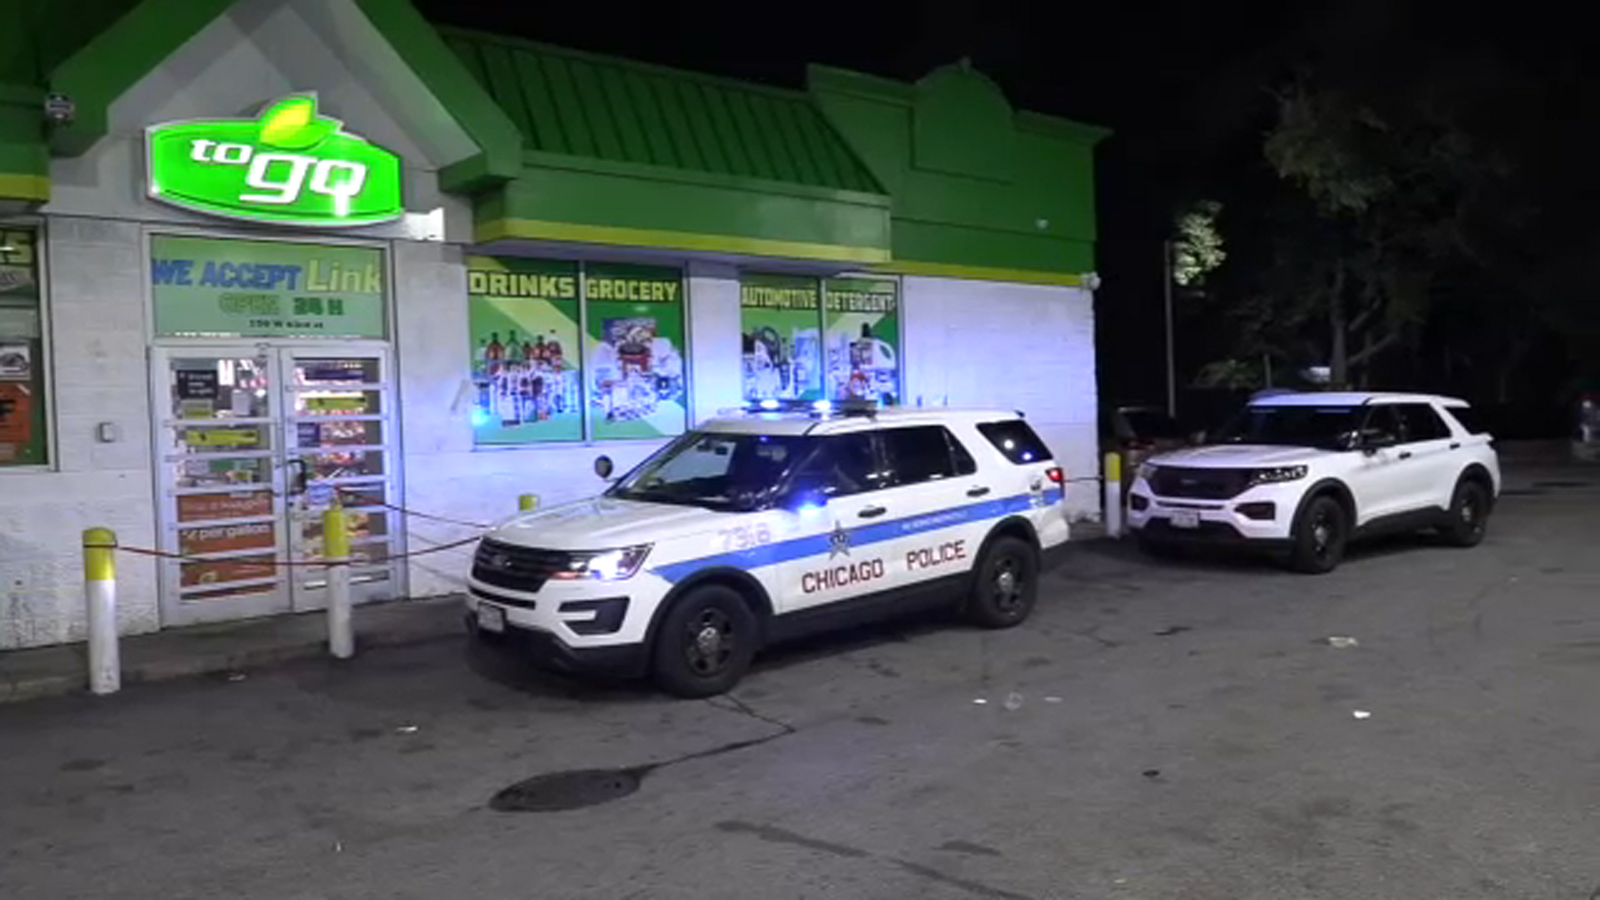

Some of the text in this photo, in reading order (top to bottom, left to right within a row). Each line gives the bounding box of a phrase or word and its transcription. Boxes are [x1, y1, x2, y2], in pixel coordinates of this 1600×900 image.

[190, 139, 253, 164] to
[152, 259, 382, 292] WE ACCEPT Link
[468, 272, 576, 298] DRINKS
[585, 279, 679, 301] GROCERY
[742, 286, 817, 309] AUTOMOTIVE
[826, 291, 896, 312] DETERGENT
[801, 539, 966, 594] CHICAGO POLICE
